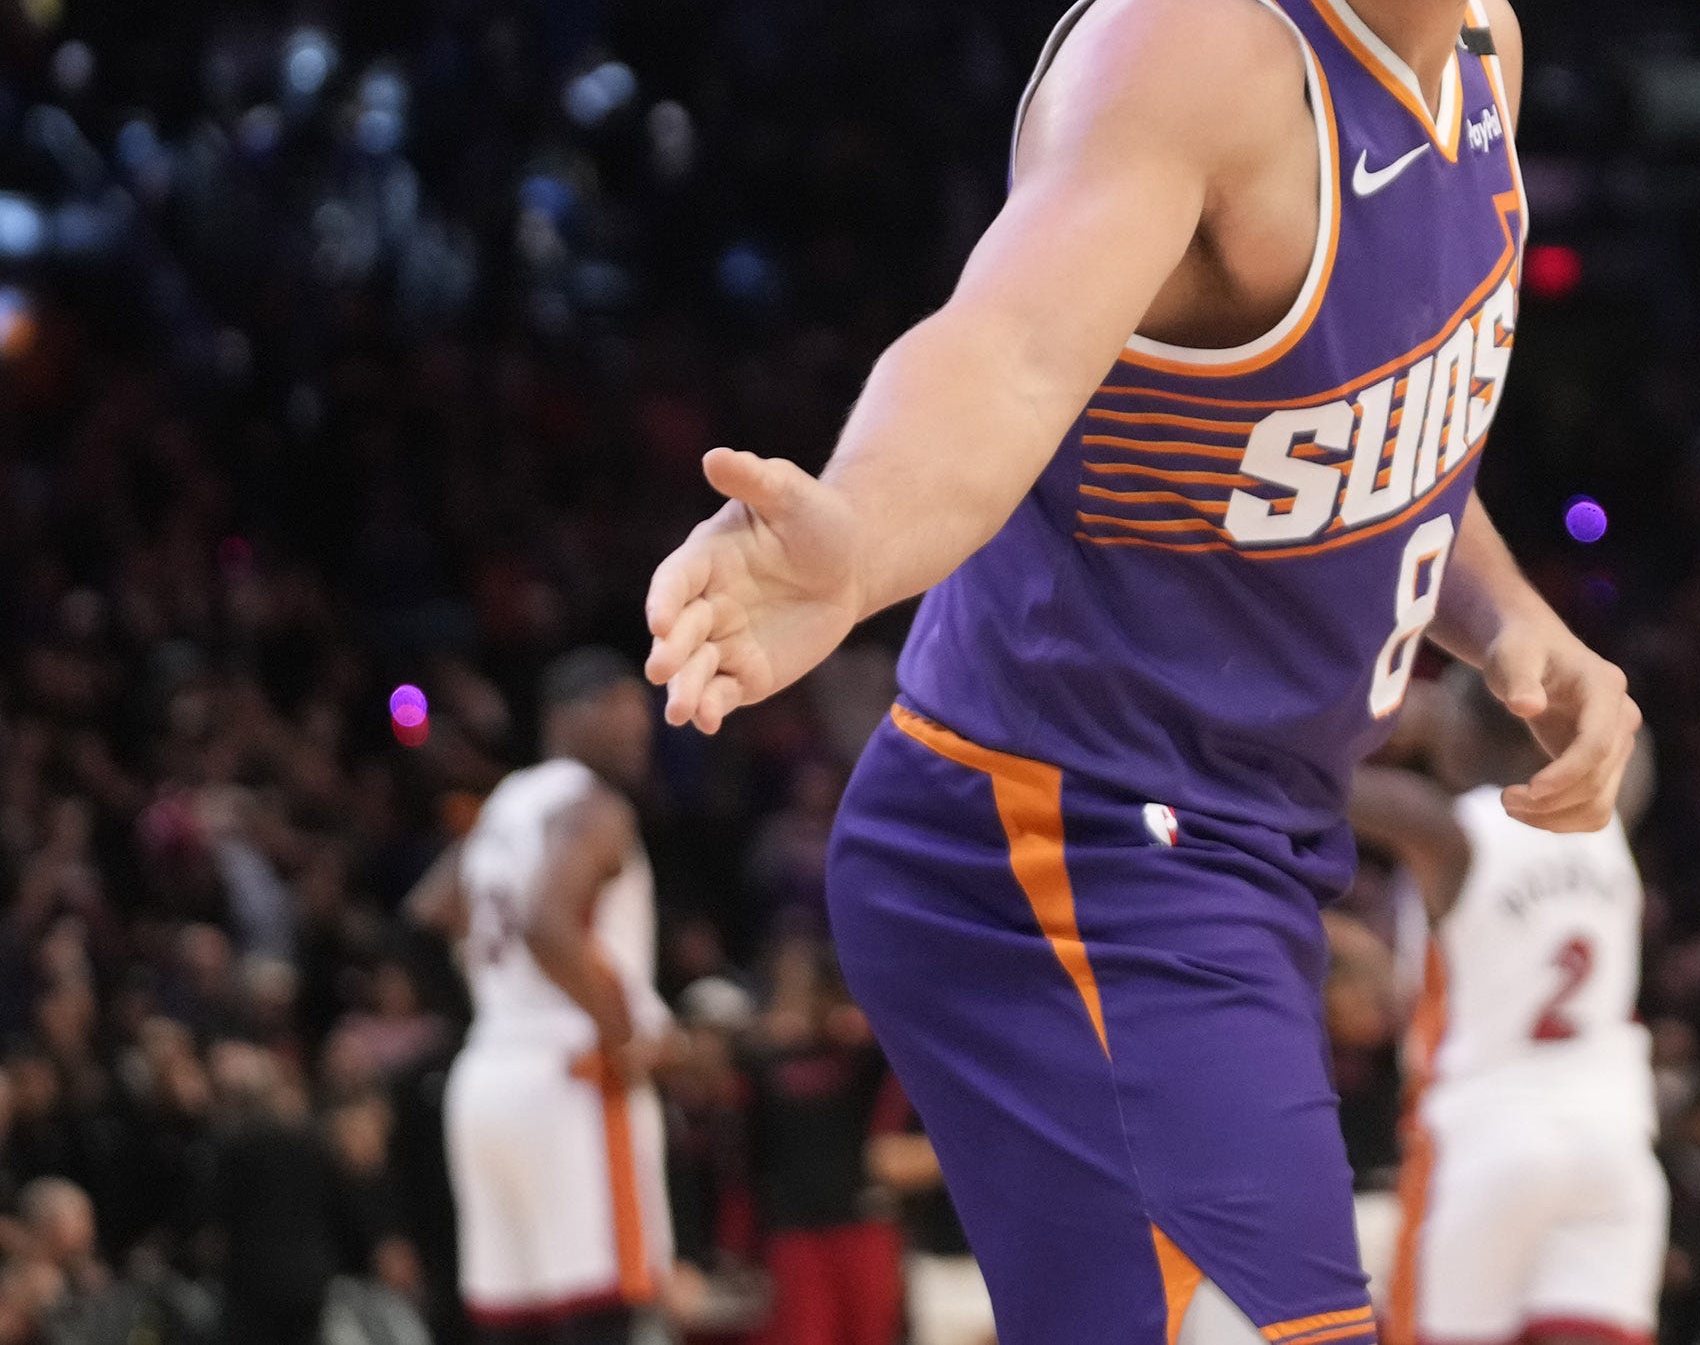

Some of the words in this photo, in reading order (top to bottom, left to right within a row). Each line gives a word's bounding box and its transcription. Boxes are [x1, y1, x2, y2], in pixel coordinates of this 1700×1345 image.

[1223, 277, 1516, 545] SUNS
[1367, 512, 1455, 720] 8
[1528, 931, 1597, 1043] 2
